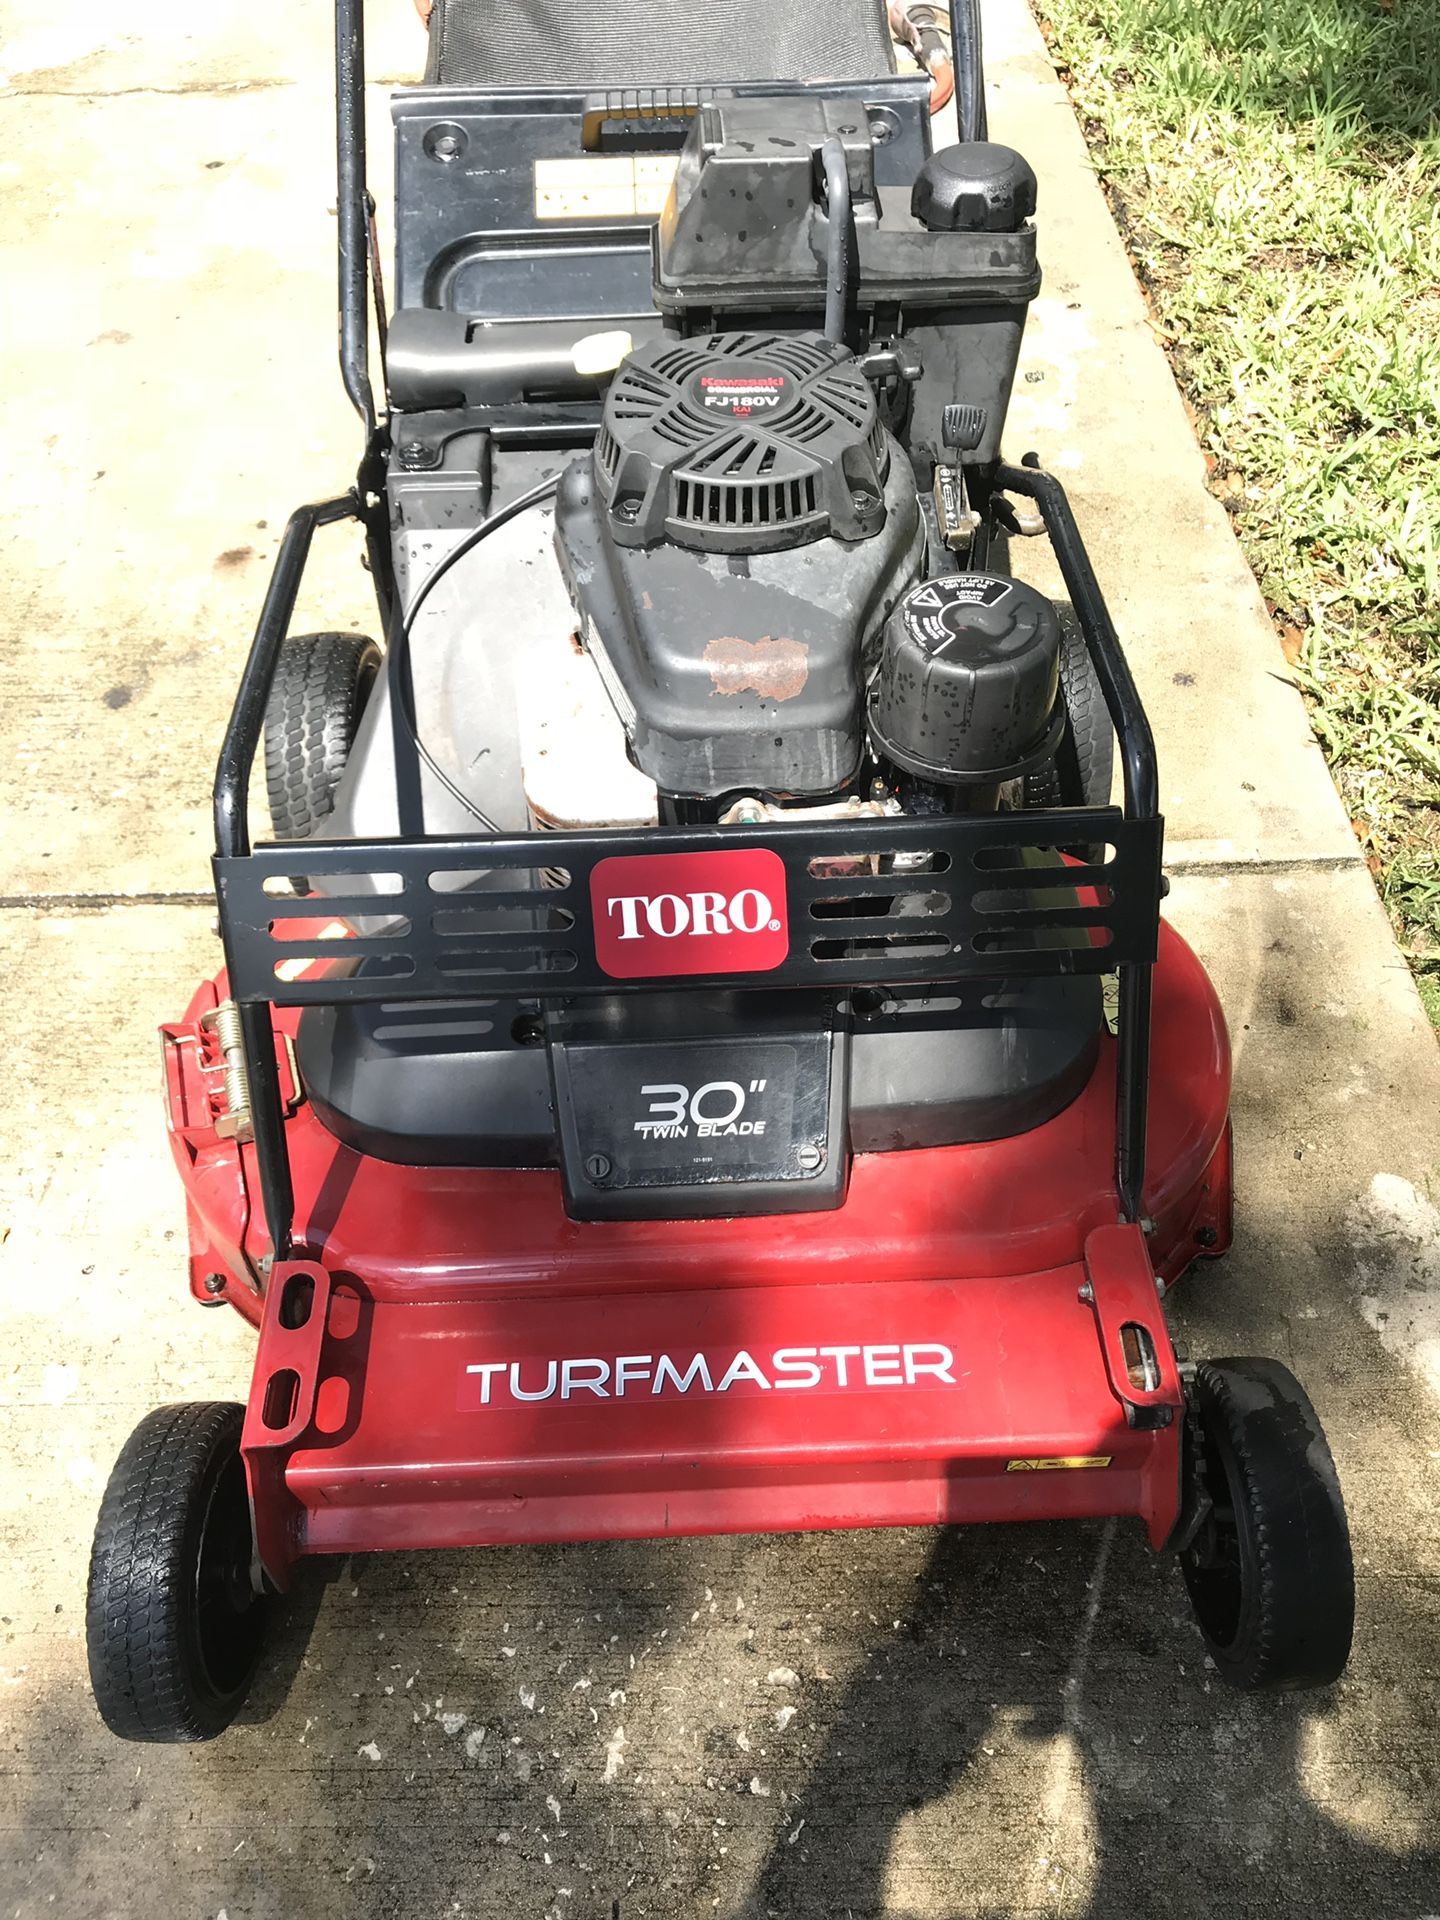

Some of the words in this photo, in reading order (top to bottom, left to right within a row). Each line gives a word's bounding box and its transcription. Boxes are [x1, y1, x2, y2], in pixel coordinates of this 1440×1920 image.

[700, 377, 784, 387] Kawasaki
[704, 396, 780, 407] FJ180V
[607, 888, 773, 940] TORO
[633, 1079, 767, 1131] 30"
[640, 1125, 689, 1140] TWIN
[697, 1120, 767, 1138] BLADE
[465, 1342, 958, 1405] TURFMASTER
